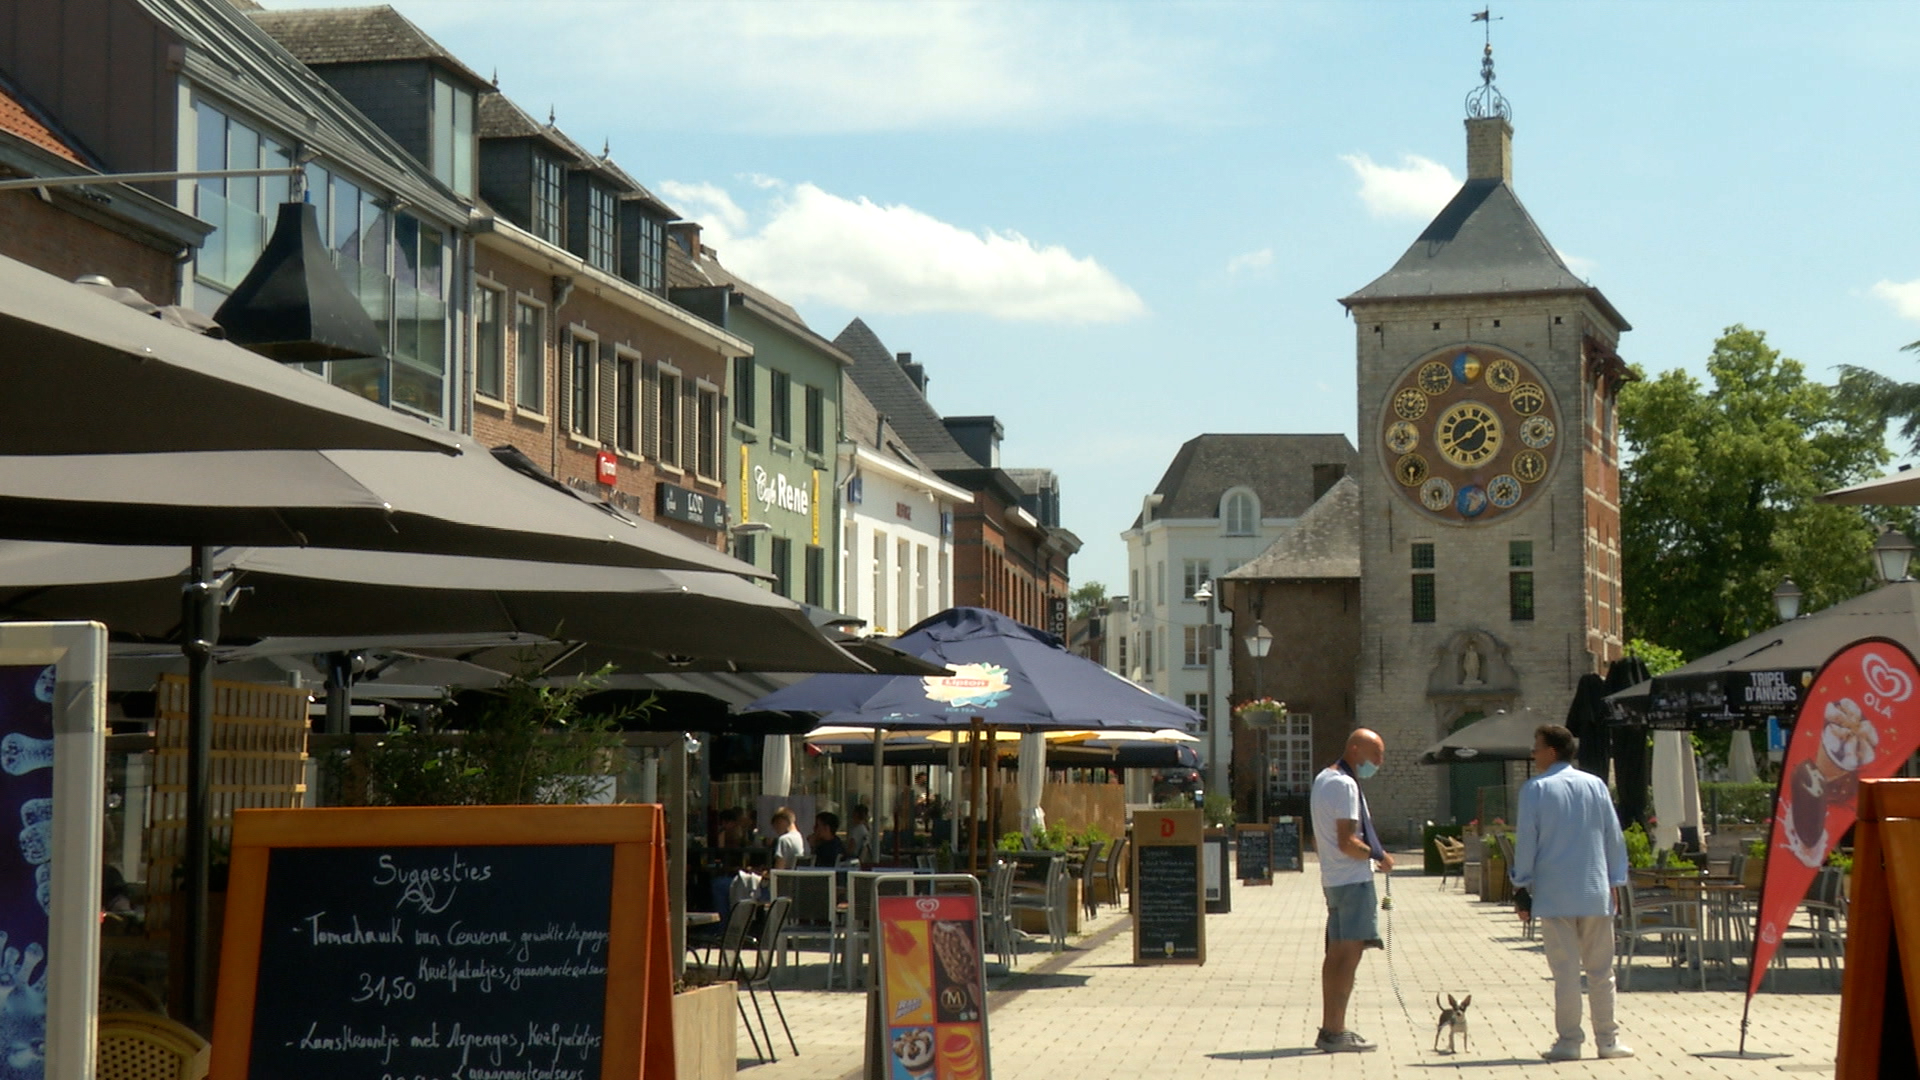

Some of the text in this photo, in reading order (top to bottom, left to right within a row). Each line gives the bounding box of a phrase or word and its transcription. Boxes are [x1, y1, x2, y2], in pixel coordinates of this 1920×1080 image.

[778, 472, 809, 516] René
[1750, 671, 1788, 687] TRIPEL
[1745, 686, 1797, 702] D'ANVERS
[1863, 692, 1893, 719] OLA
[373, 852, 492, 911] Suggesties
[351, 972, 417, 1005] 31,50
[410, 1021, 440, 1048] met
